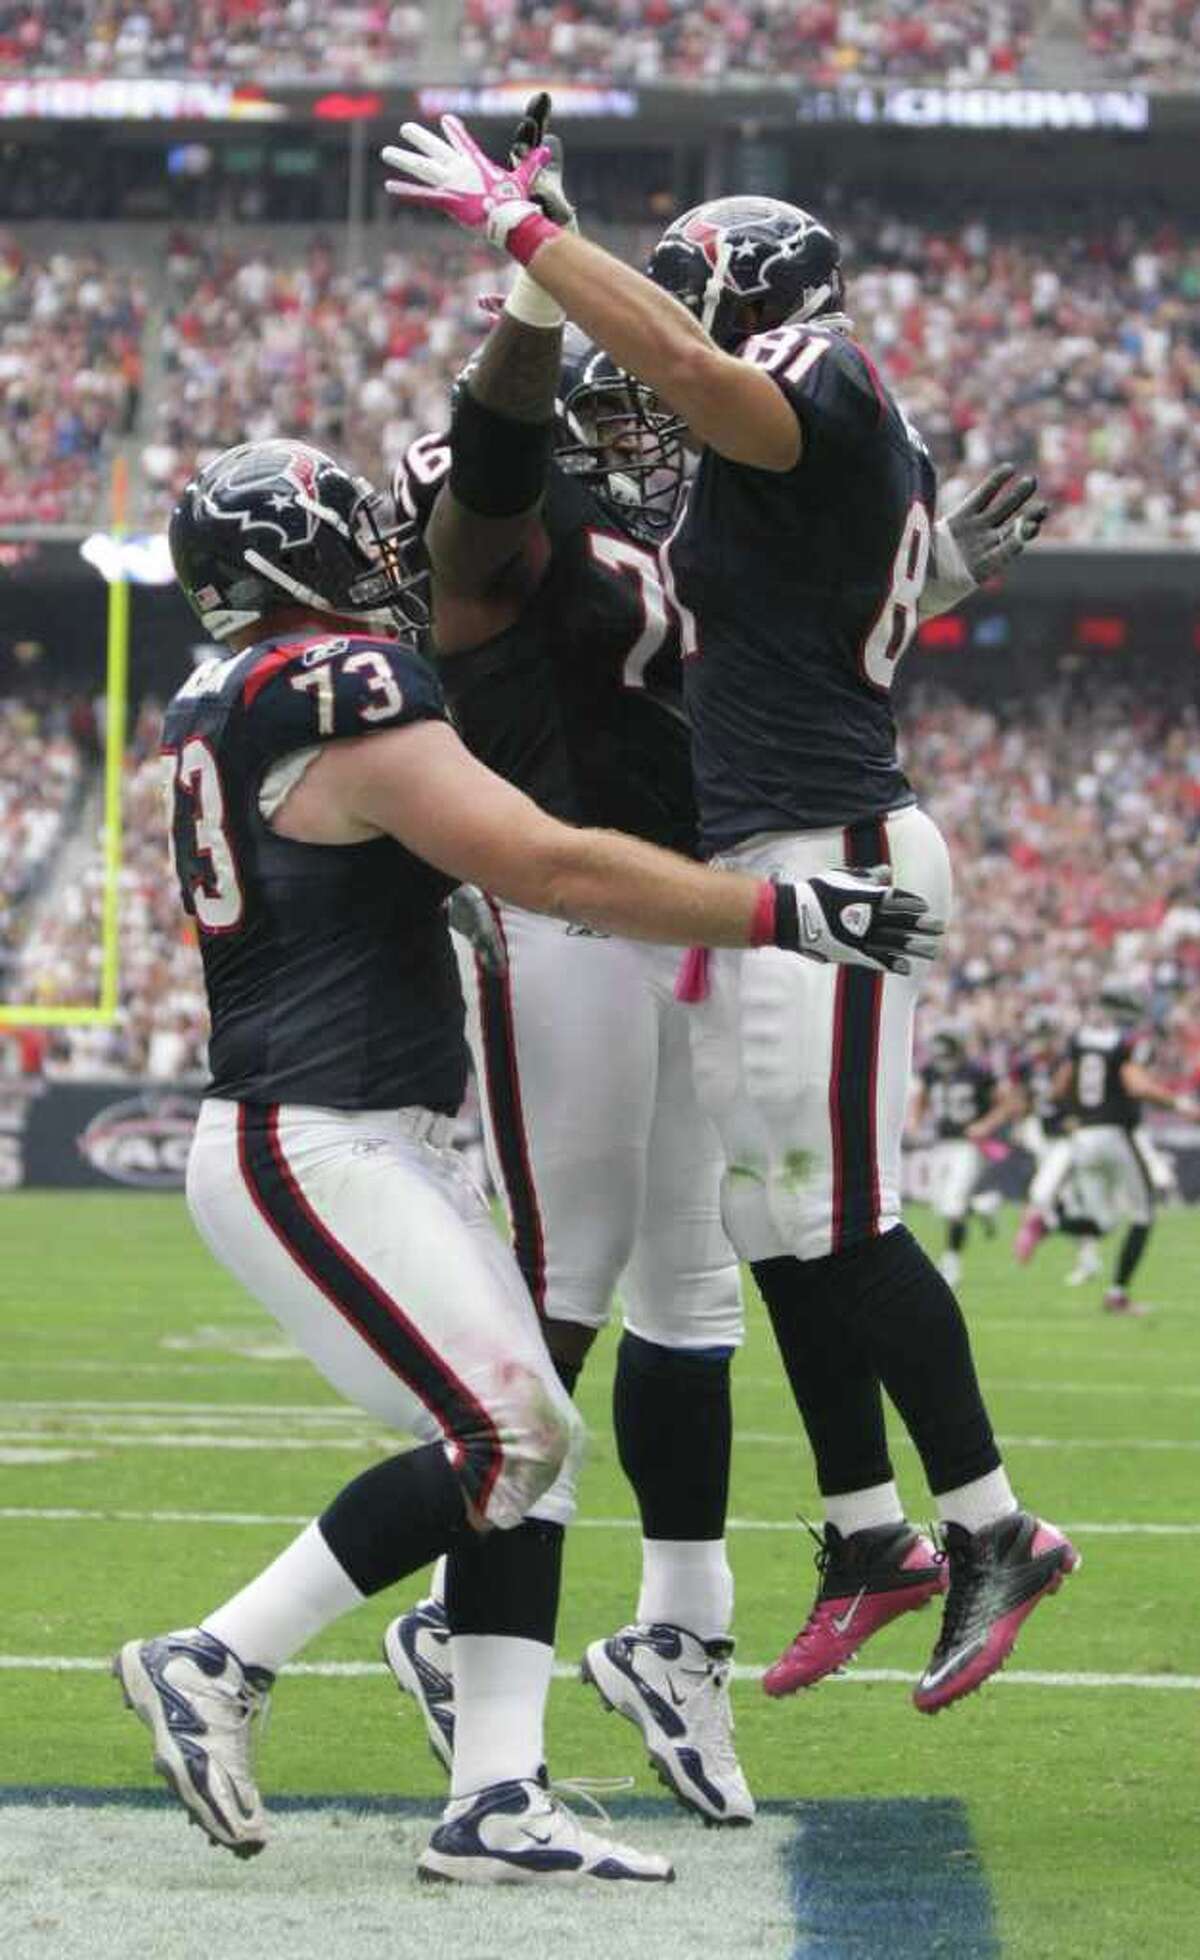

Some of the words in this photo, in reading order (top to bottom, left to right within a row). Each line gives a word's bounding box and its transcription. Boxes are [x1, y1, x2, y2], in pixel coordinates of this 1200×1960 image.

[742, 324, 832, 384] 81
[589, 532, 668, 688] 7
[864, 500, 931, 690] 8
[290, 651, 403, 735] 73
[164, 739, 242, 927] 3
